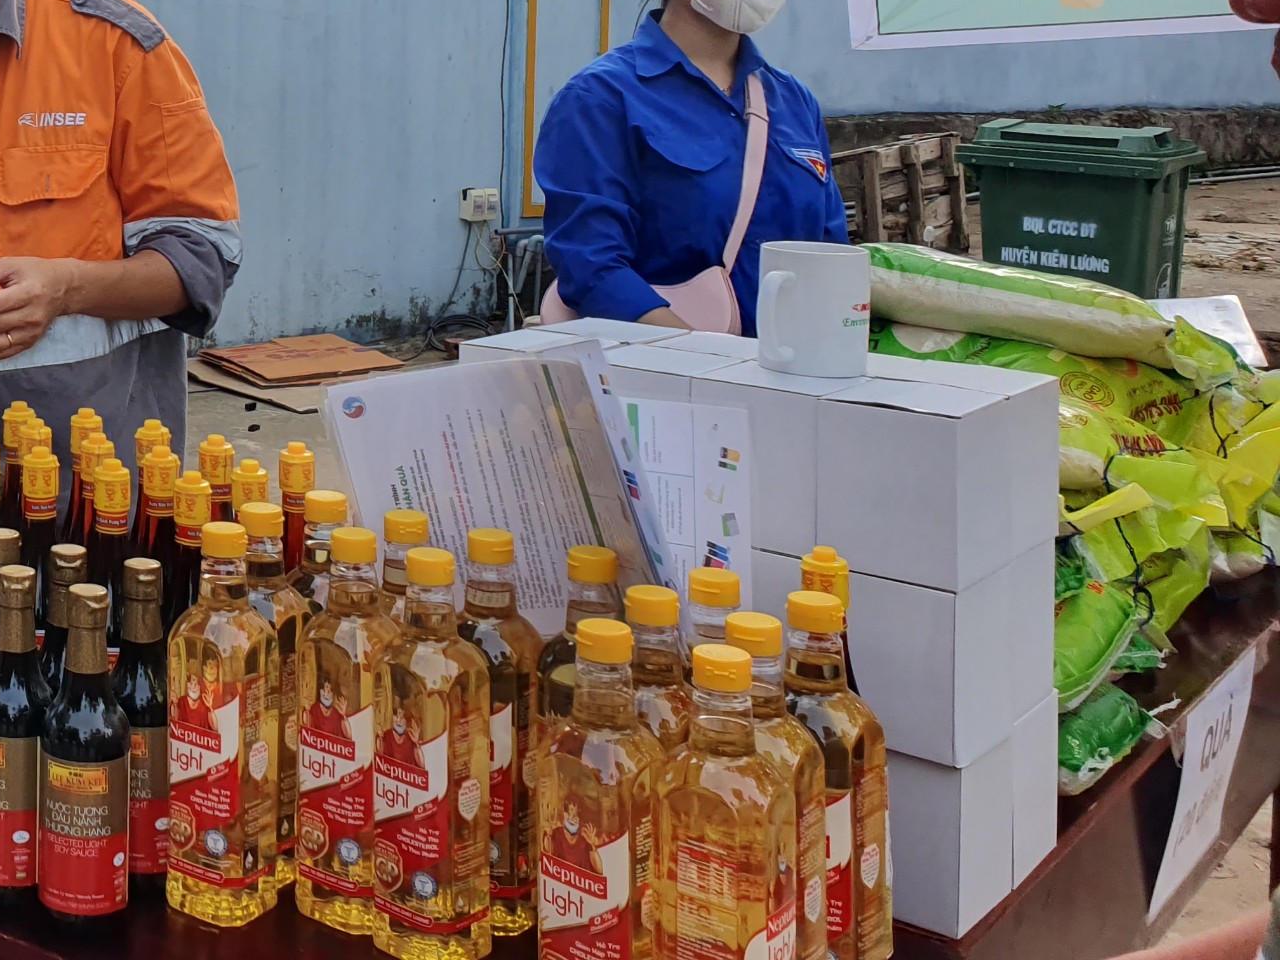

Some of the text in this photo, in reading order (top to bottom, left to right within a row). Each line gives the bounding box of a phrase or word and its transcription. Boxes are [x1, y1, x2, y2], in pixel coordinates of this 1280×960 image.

[39, 112, 87, 127] INSEE
[1023, 216, 1045, 234] BQL
[1048, 219, 1079, 237] CTCC
[1001, 246, 1037, 267] HUYỆN
[395, 465, 408, 485] QUÀ
[390, 484, 400, 505] TRÌNH
[170, 723, 219, 749] Neptune
[301, 729, 354, 757] Neptune
[170, 742, 203, 772] Light
[302, 748, 336, 779] Light
[52, 773, 63, 782] LEE
[375, 758, 427, 788] Neptune
[376, 777, 410, 810] Light
[48, 833, 107, 849] SELECTED LIGHT
[54, 845, 98, 857] SOY SAUCE
[397, 834, 439, 850] CHOLESTEROL
[543, 855, 605, 895] Neptune
[544, 879, 584, 918] Light
[768, 904, 796, 933] Neptun
